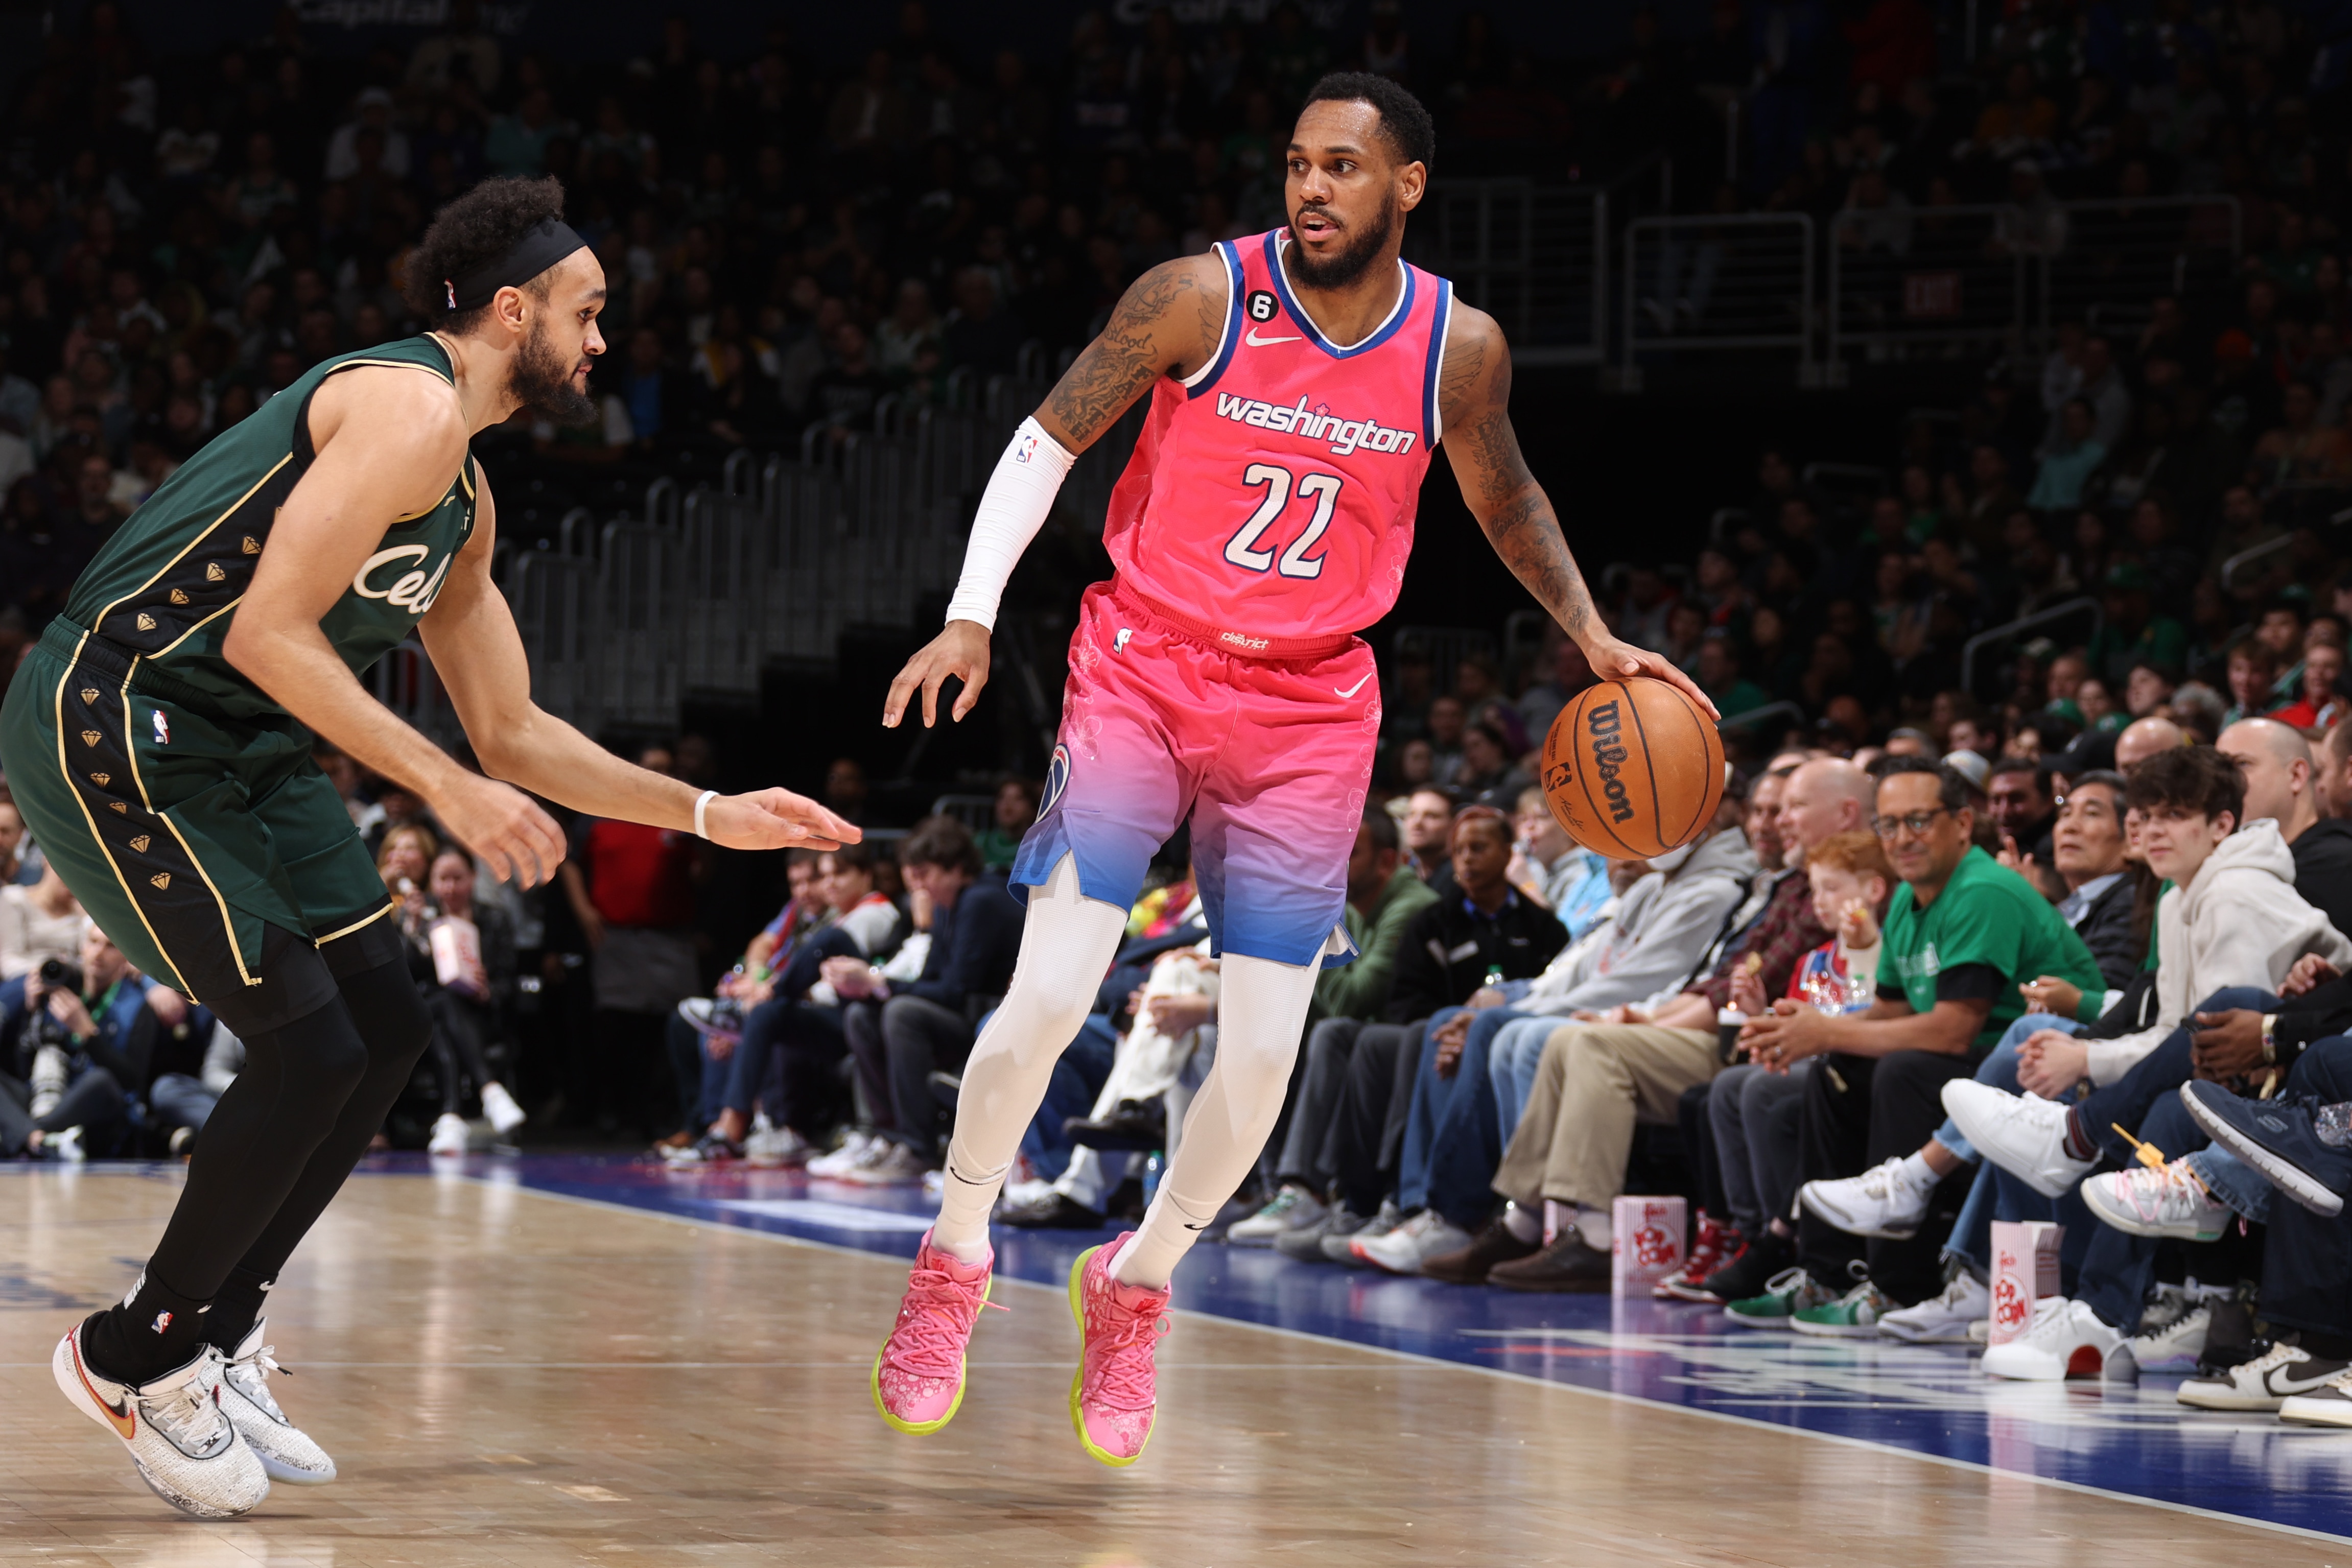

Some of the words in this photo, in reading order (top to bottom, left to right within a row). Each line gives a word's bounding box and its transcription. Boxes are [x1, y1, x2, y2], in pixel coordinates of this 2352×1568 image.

[1252, 294, 1272, 320] 6
[1215, 392, 1417, 456] washington
[1222, 462, 1344, 580] 22
[1220, 631, 1269, 649] district
[1587, 699, 1635, 824] Wilson
